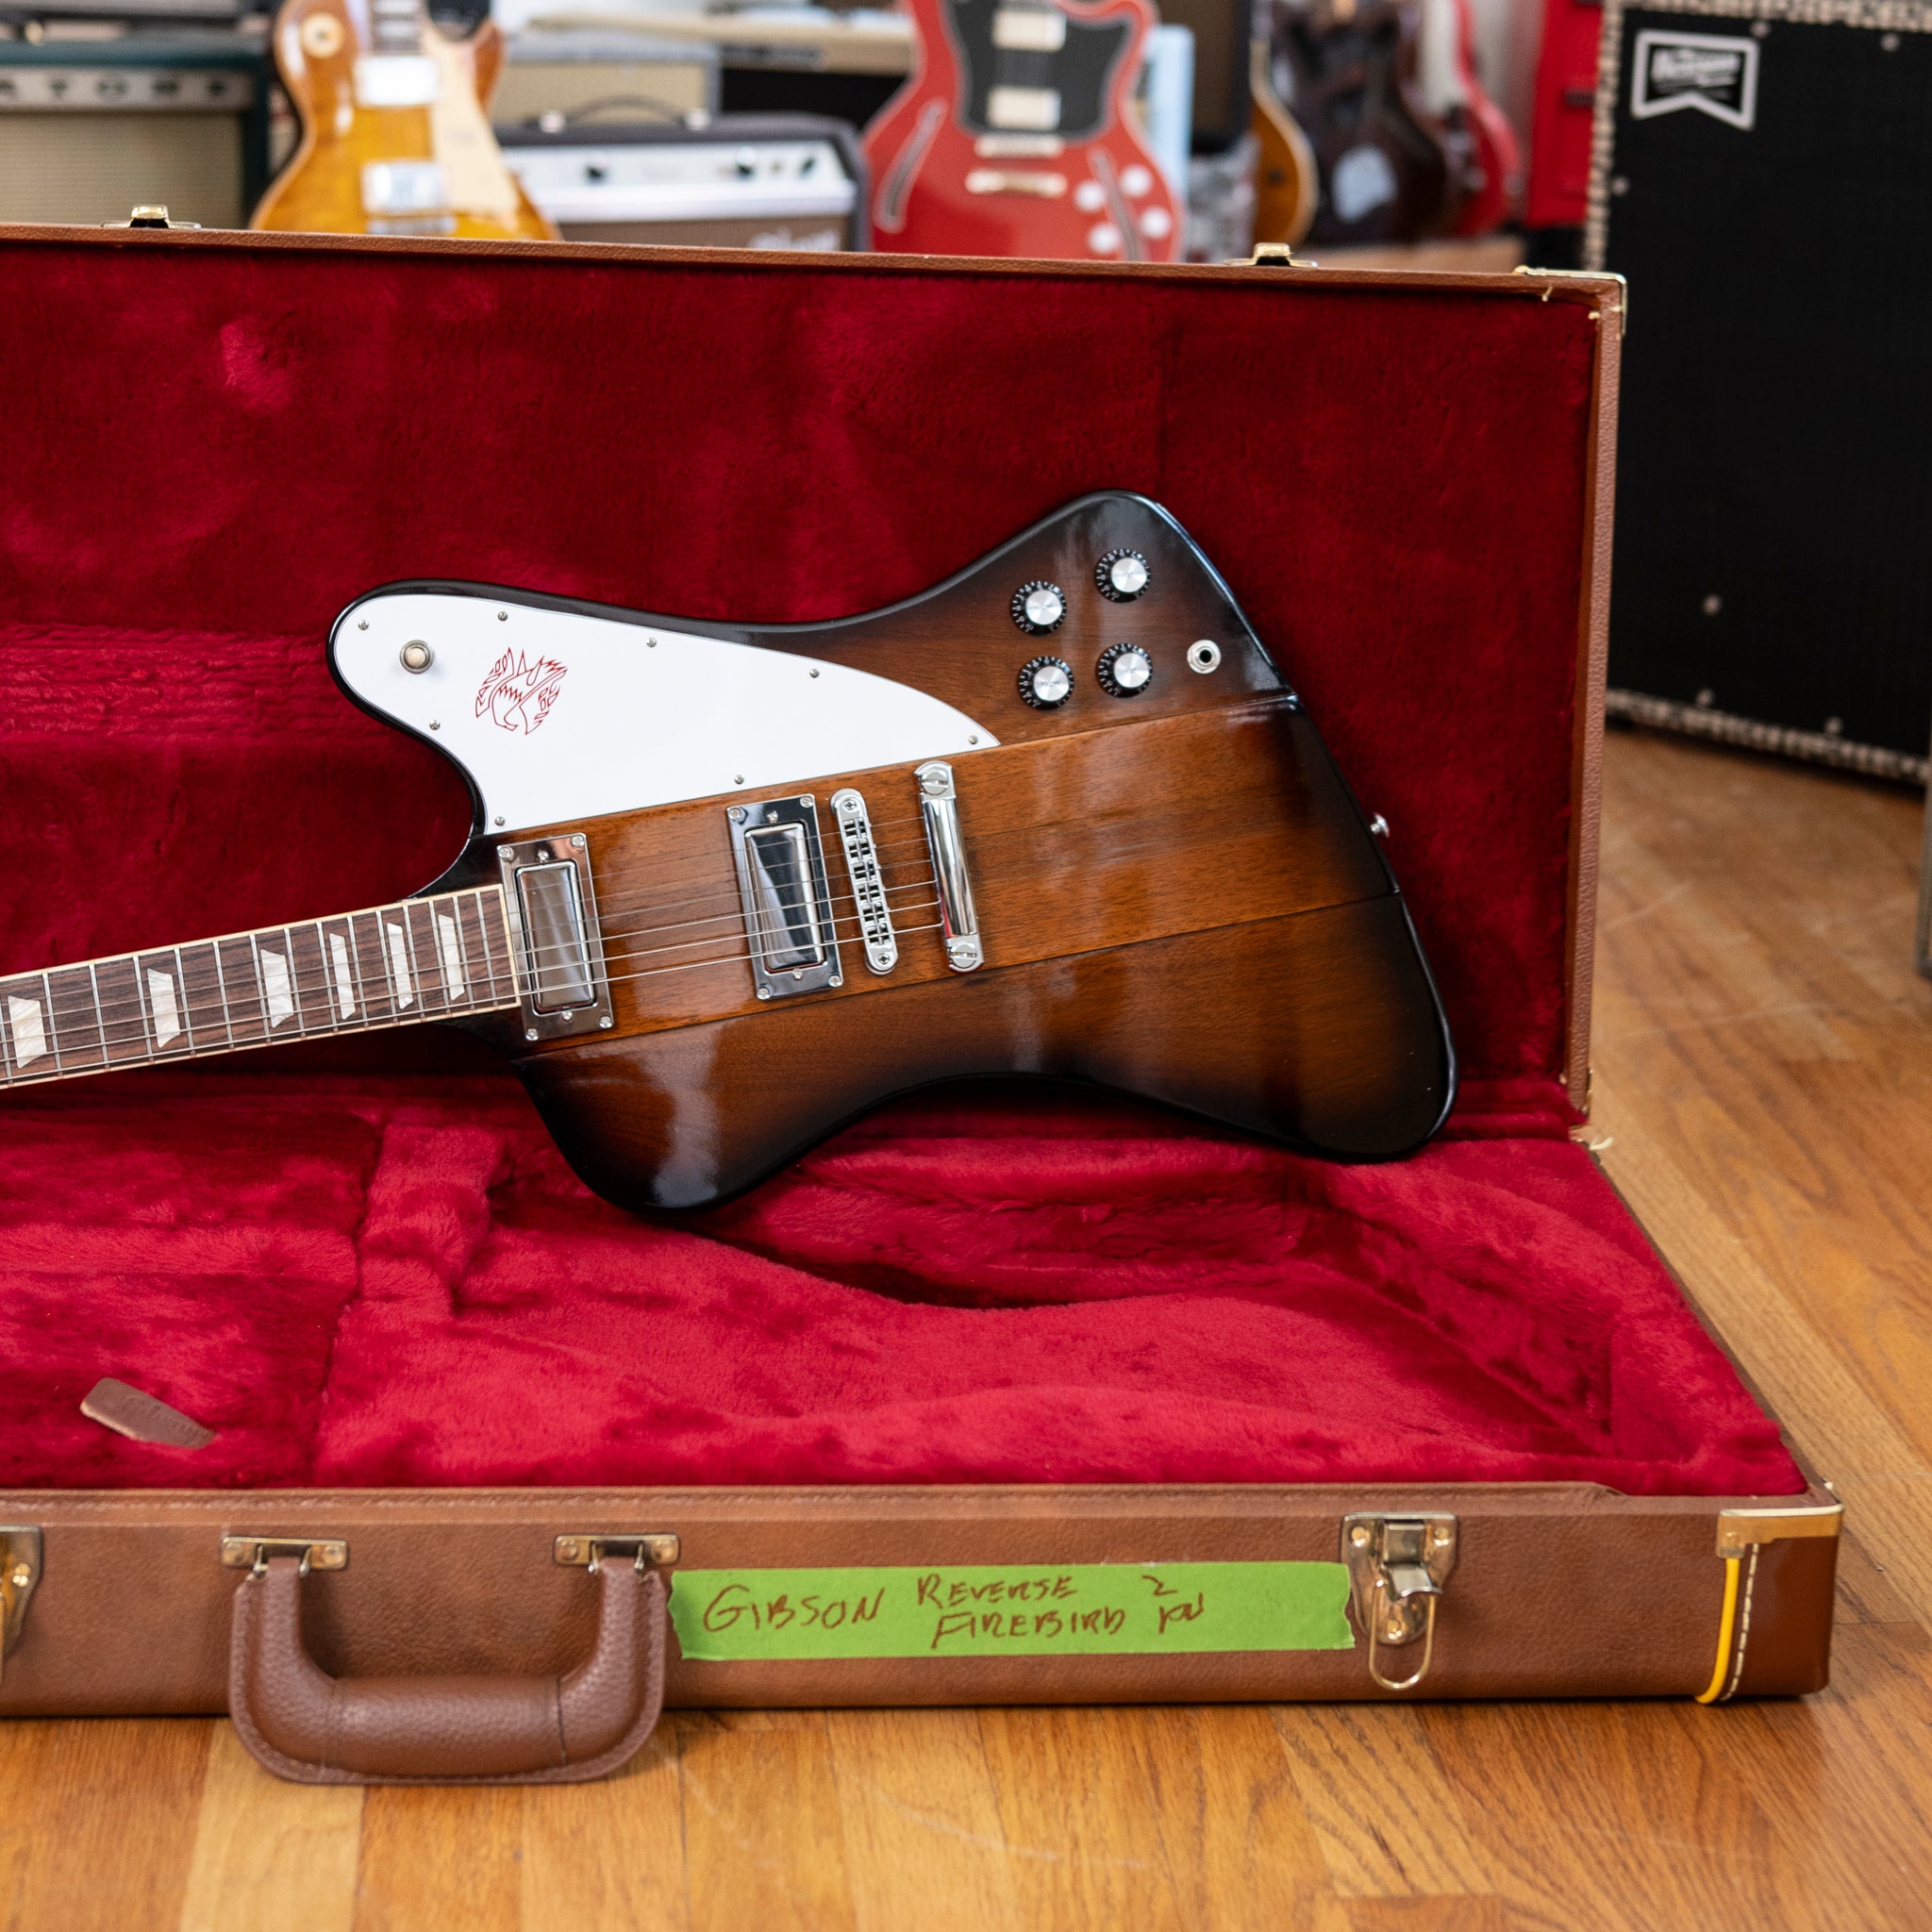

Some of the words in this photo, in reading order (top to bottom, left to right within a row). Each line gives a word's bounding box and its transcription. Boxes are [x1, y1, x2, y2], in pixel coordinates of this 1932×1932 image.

[917, 1573, 1078, 1609] REVERSE
[1141, 1574, 1178, 1596] 2
[703, 1584, 886, 1633] GIBSON
[930, 1607, 1125, 1649] FIREBIRD
